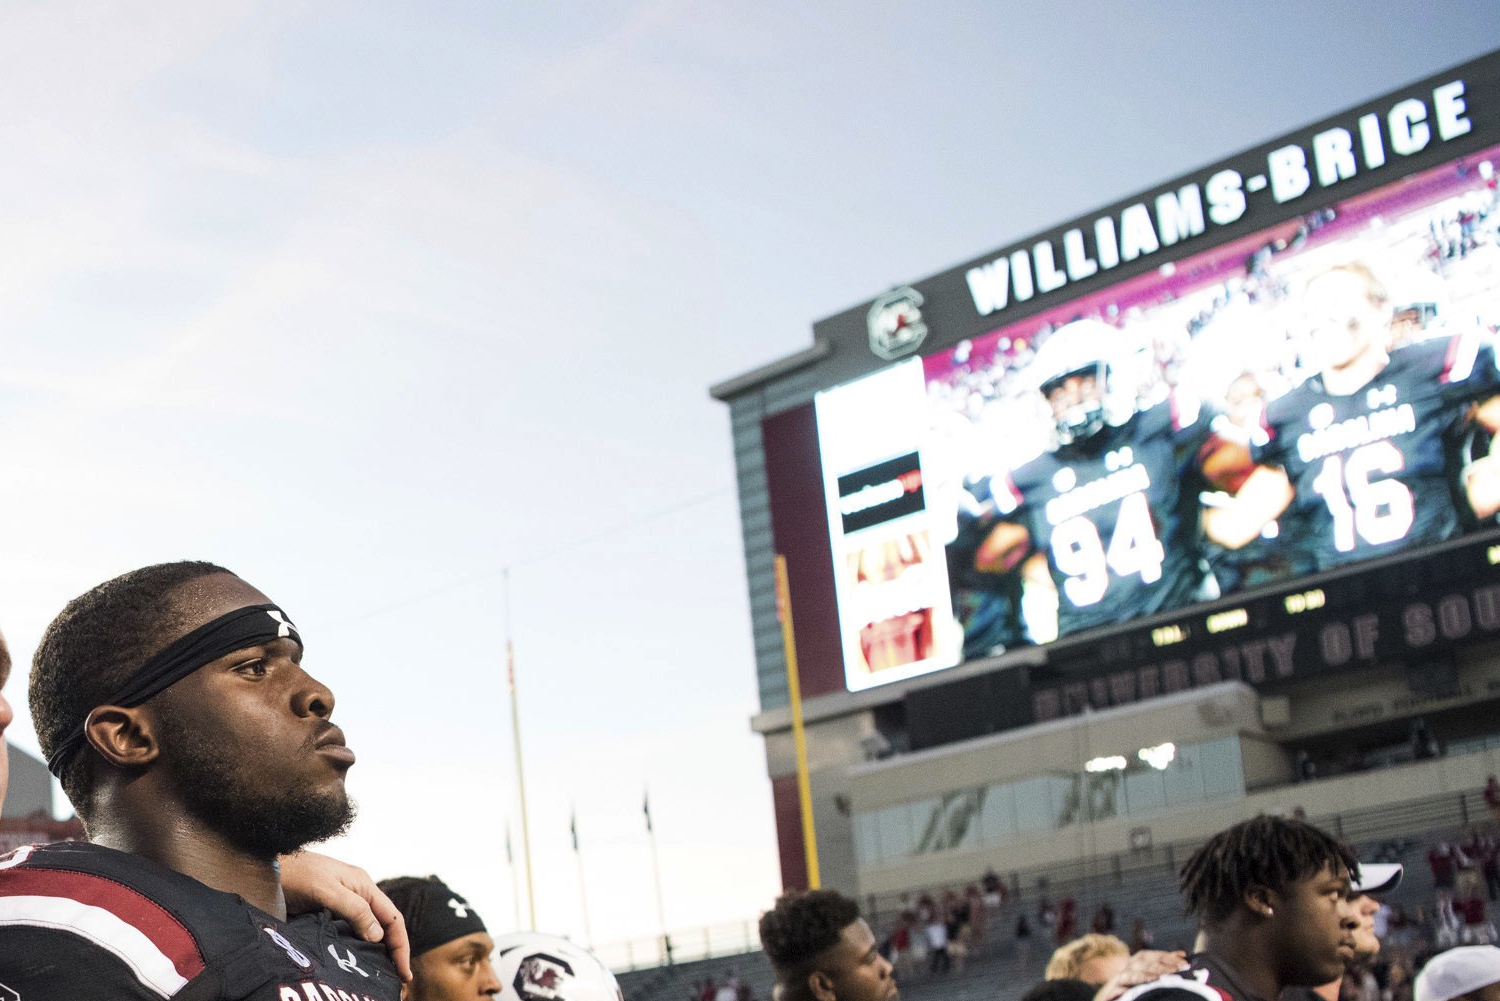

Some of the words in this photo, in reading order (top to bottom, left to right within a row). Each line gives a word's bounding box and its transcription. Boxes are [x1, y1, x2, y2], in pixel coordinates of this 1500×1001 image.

[965, 79, 1473, 317] WILLIAMS-BRICE
[1050, 491, 1164, 607] 94
[1314, 440, 1414, 553] 16
[1319, 613, 1381, 667] OF
